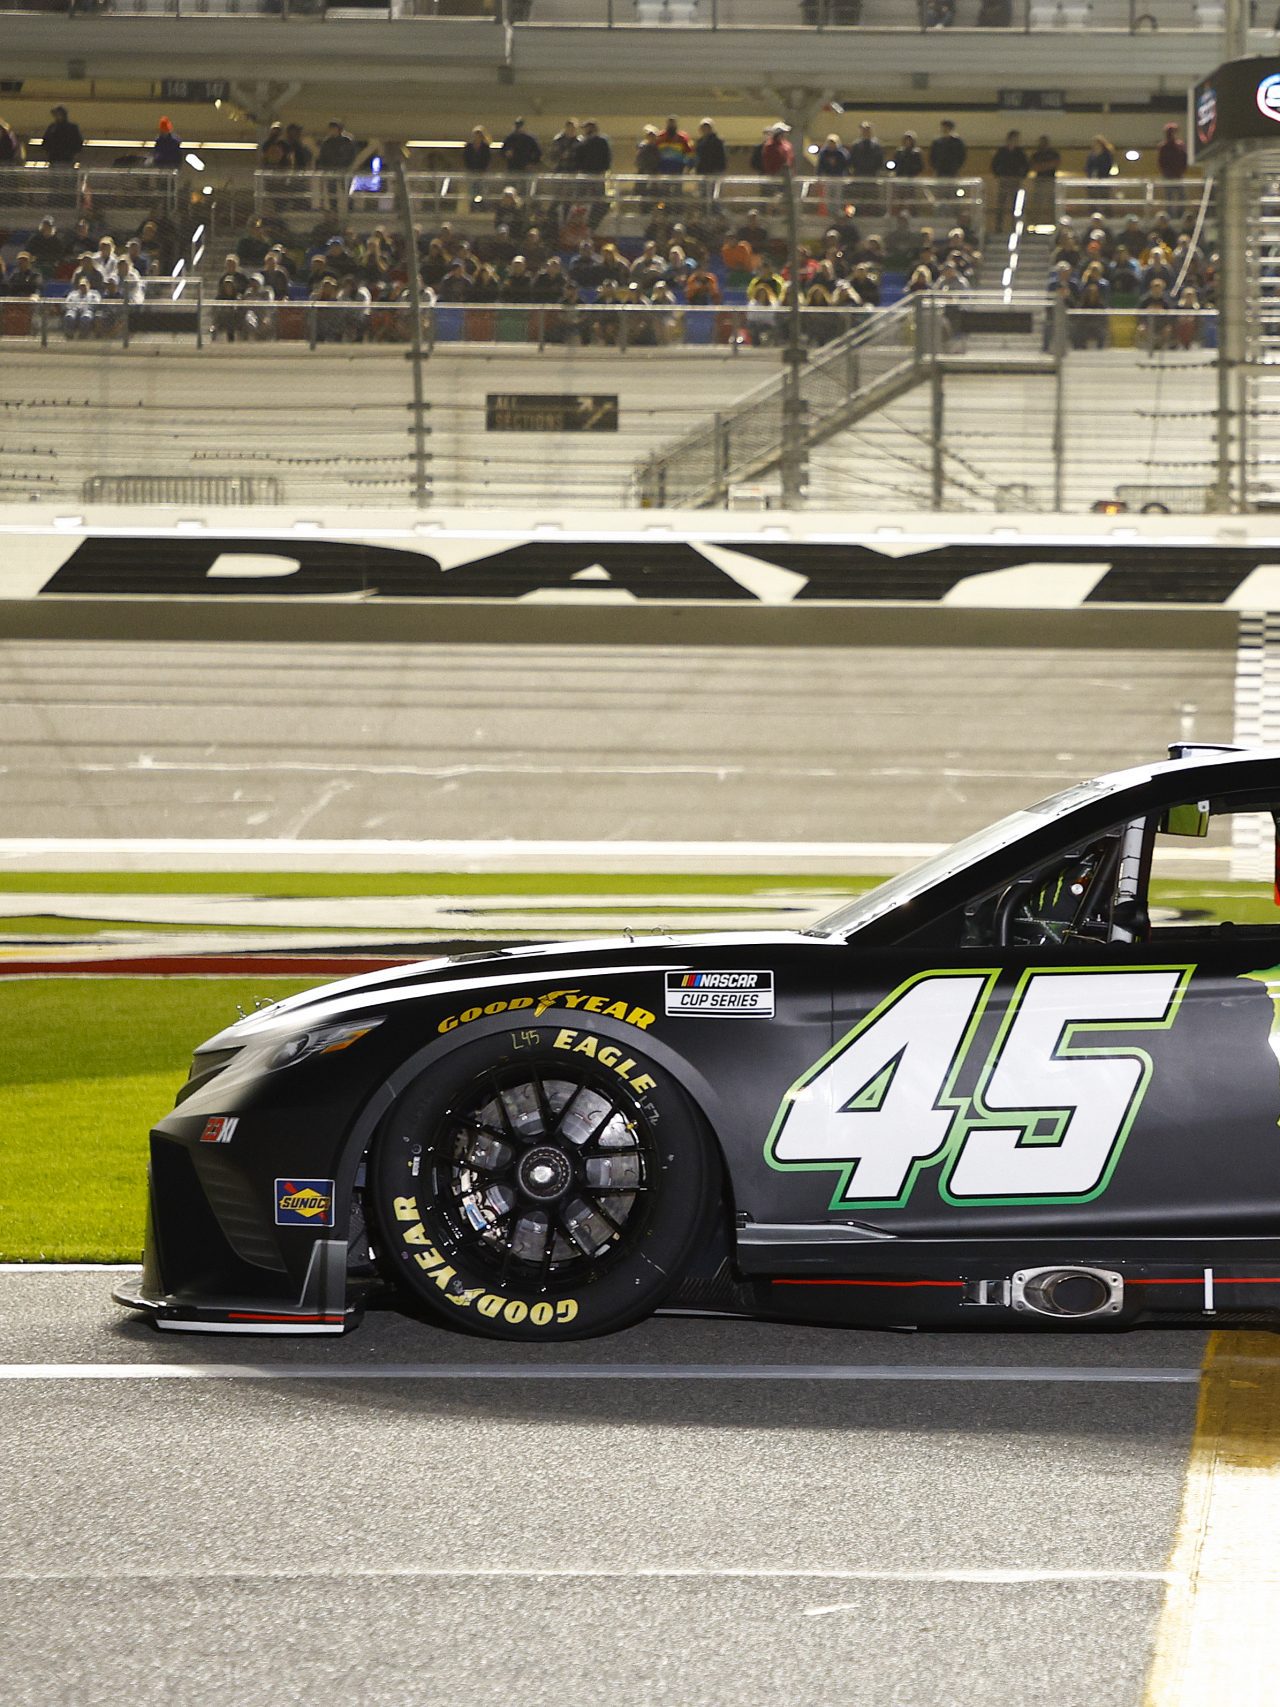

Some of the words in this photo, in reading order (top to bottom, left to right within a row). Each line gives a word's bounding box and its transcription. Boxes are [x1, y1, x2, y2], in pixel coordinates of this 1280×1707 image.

[681, 994, 708, 1006] CUP
[710, 994, 759, 1007] SERIES
[700, 974, 758, 988] NASCAR
[553, 1028, 658, 1095] EAGLE
[763, 963, 1198, 1211] 45
